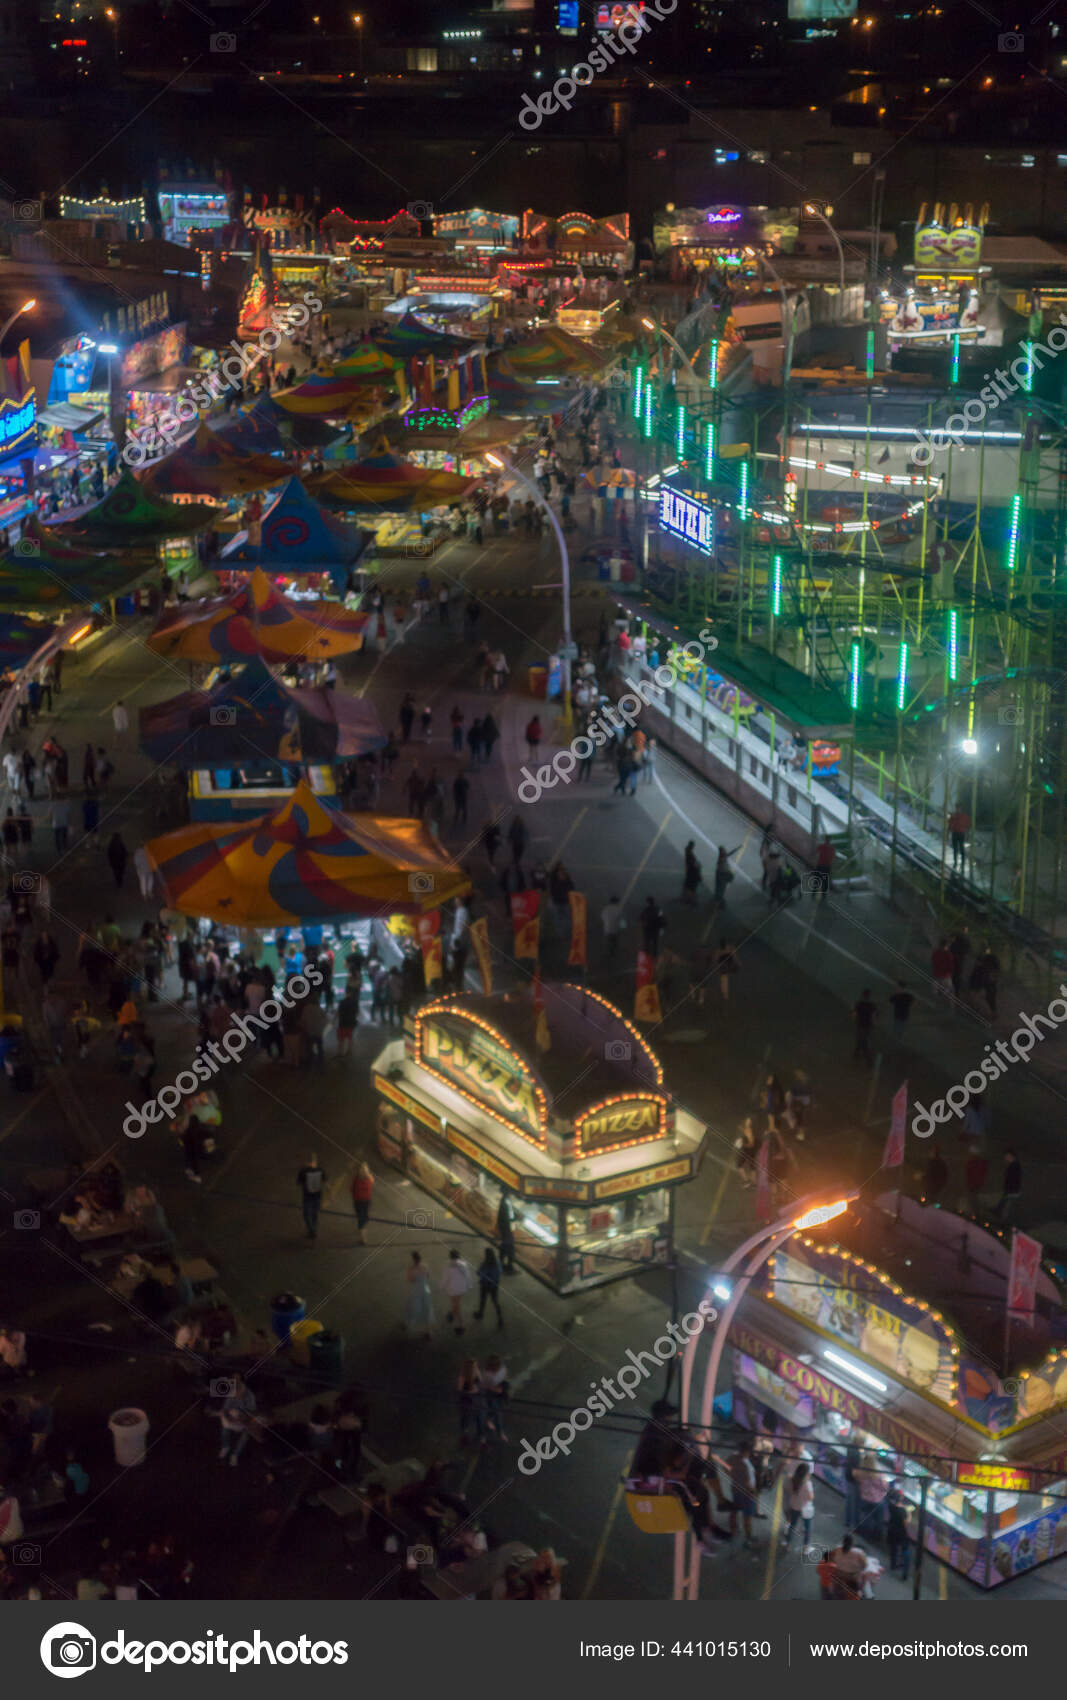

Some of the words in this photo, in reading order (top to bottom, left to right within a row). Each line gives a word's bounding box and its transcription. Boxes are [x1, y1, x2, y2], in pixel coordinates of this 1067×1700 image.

[427, 1026, 540, 1131] PIZZA
[582, 1103, 658, 1143] PIZZA
[781, 1357, 861, 1421] CONES
